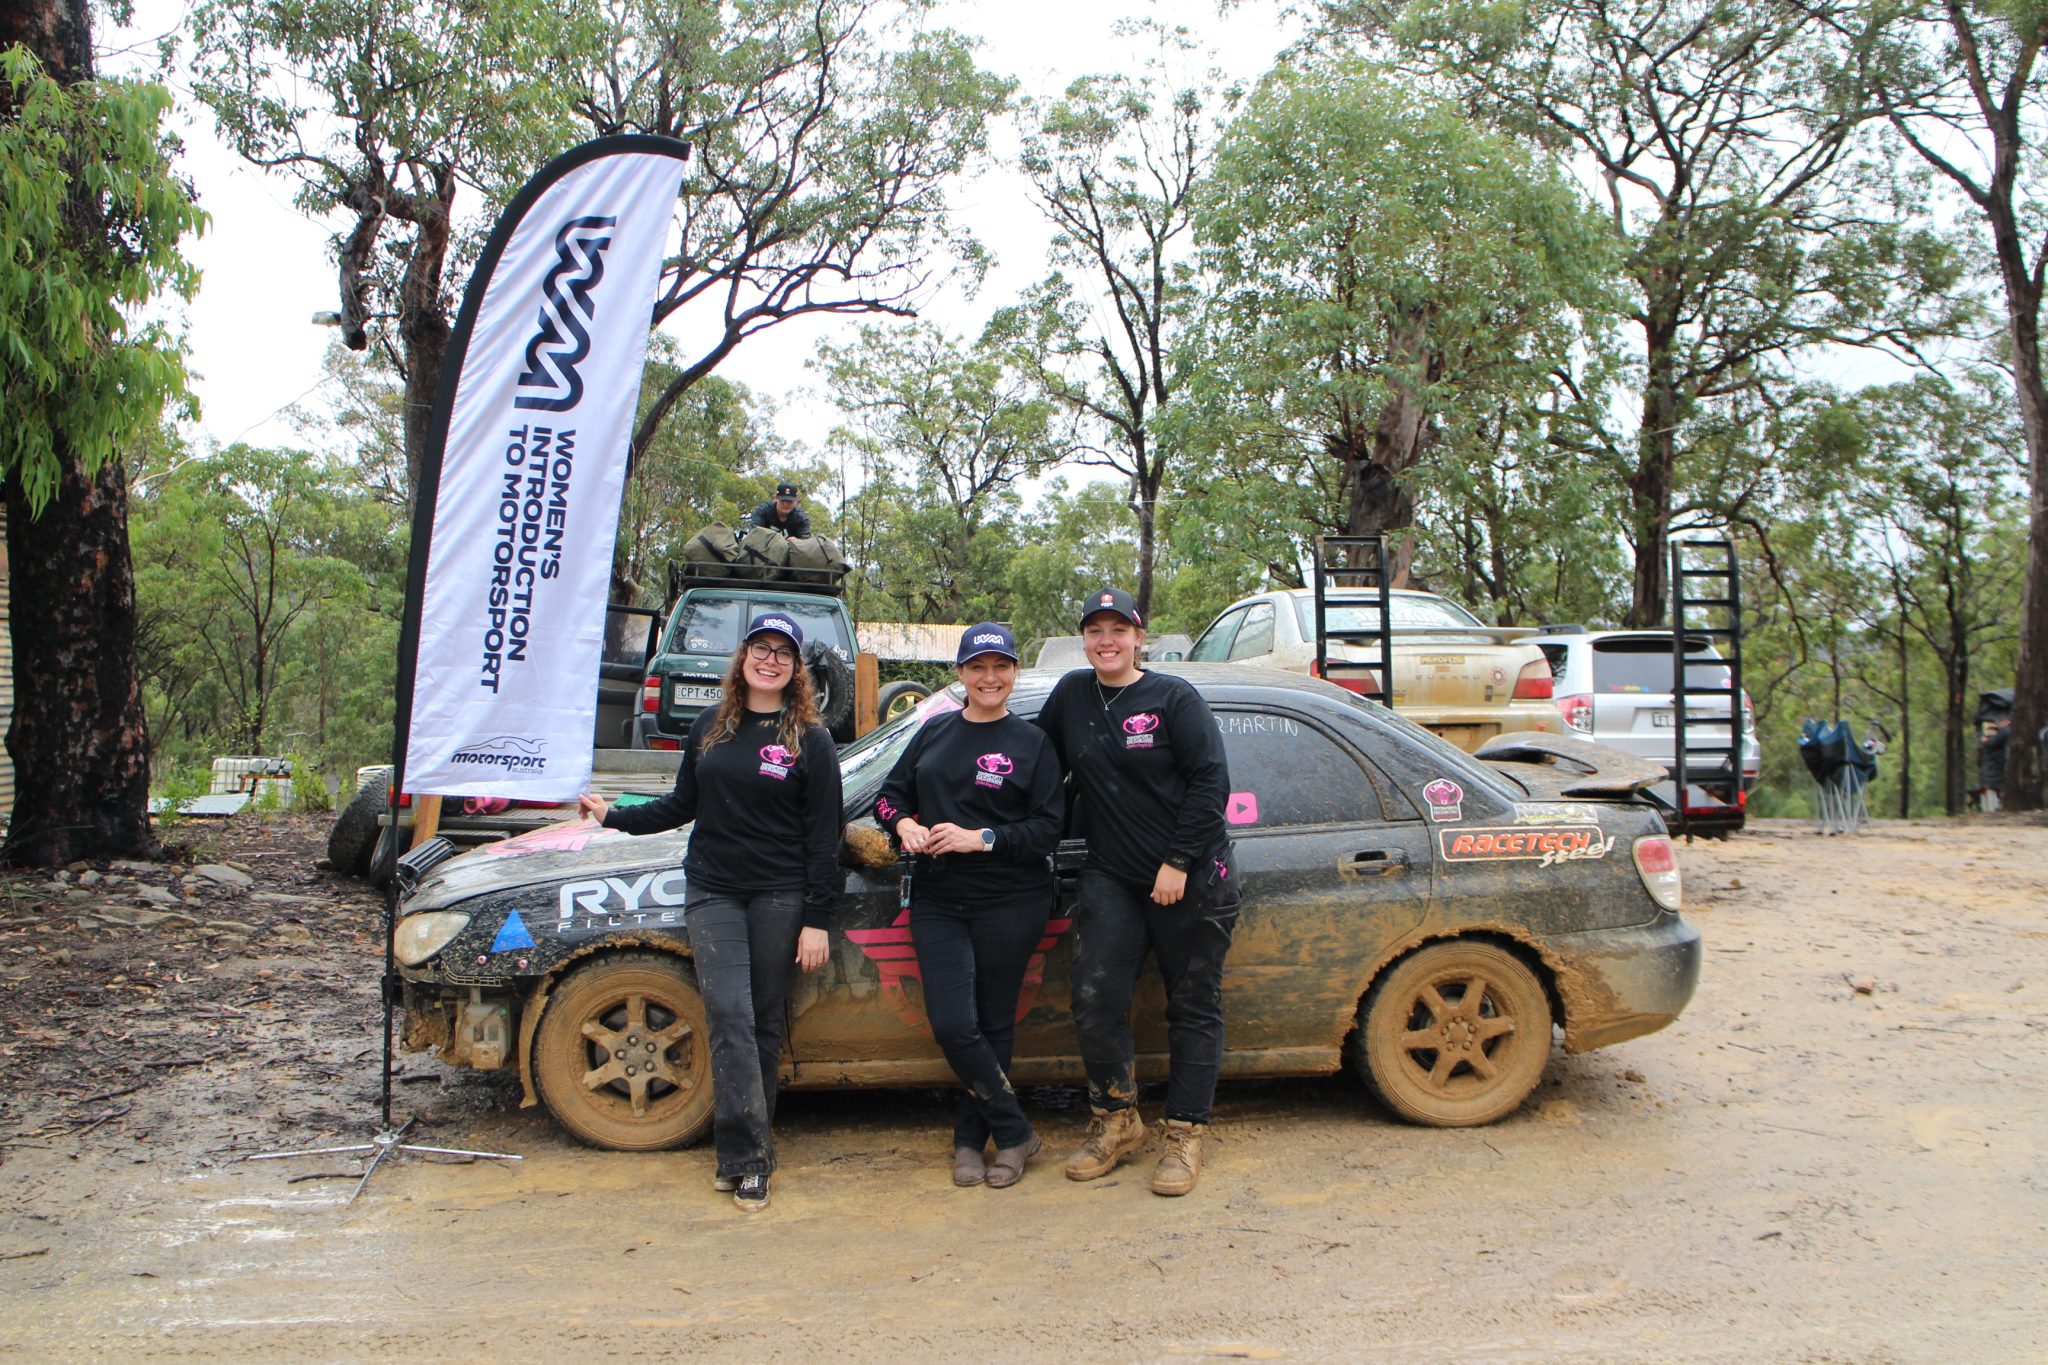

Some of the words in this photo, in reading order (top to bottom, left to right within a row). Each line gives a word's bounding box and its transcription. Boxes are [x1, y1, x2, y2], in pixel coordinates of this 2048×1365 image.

[506, 424, 528, 466] TO
[540, 429, 576, 579] WOMEN'S
[507, 426, 552, 661] INTRODUCTION
[481, 473, 522, 694] MOTORSPORT
[682, 672, 721, 680] PATROL
[1229, 715, 1298, 737] MARTIN
[450, 752, 546, 771] motorsport
[511, 766, 544, 775] australia
[560, 868, 686, 919] RYC
[557, 911, 676, 933] FILTE
